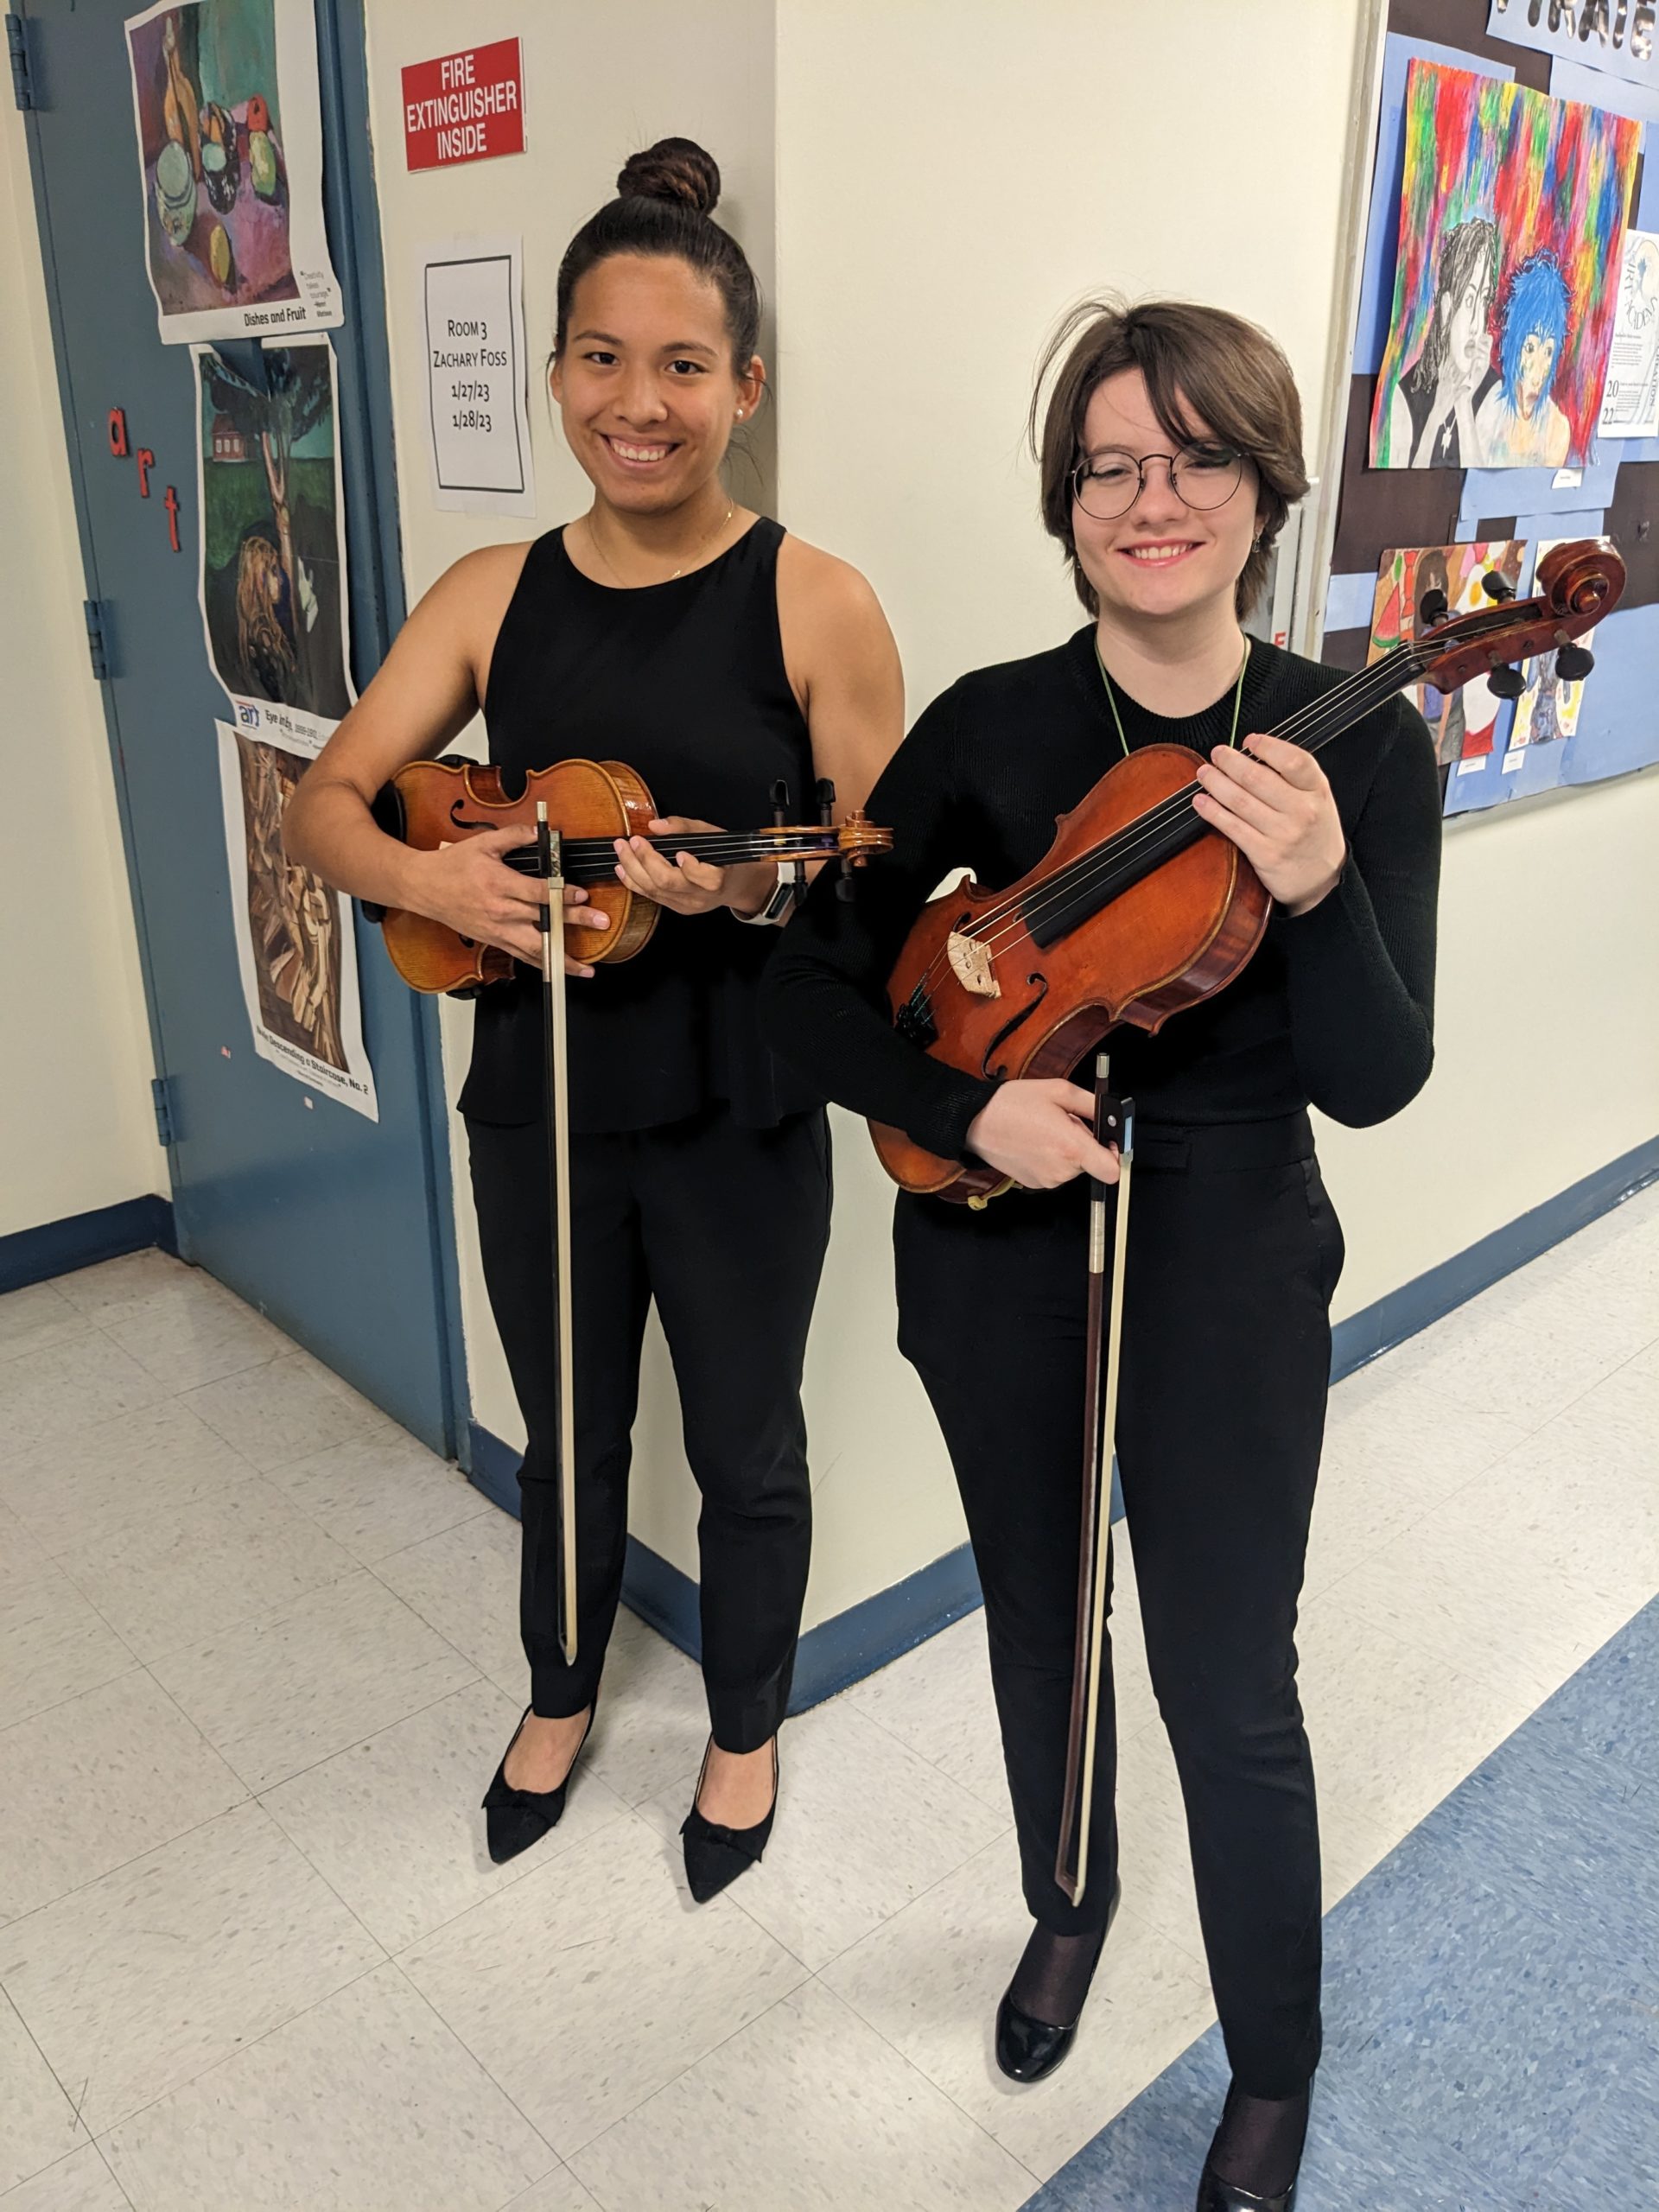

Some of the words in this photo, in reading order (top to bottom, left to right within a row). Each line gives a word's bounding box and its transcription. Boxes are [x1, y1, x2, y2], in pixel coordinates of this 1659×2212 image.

[1497, 0, 1656, 61] RATE
[441, 54, 475, 91] FIRE
[406, 80, 518, 133] EXTINGUISHER
[436, 123, 487, 160] INSIDE
[244, 312, 270, 327] Dishes
[270, 308, 286, 324] and
[286, 306, 307, 321] Fruit
[480, 321, 488, 340] 3
[451, 380, 490, 402] 1/27/23
[1606, 380, 1619, 397] 20
[452, 410, 493, 433] 1/28/23
[1602, 407, 1614, 425] 22
[349, 1078, 363, 1092] No.
[363, 1084, 369, 1096] 2
